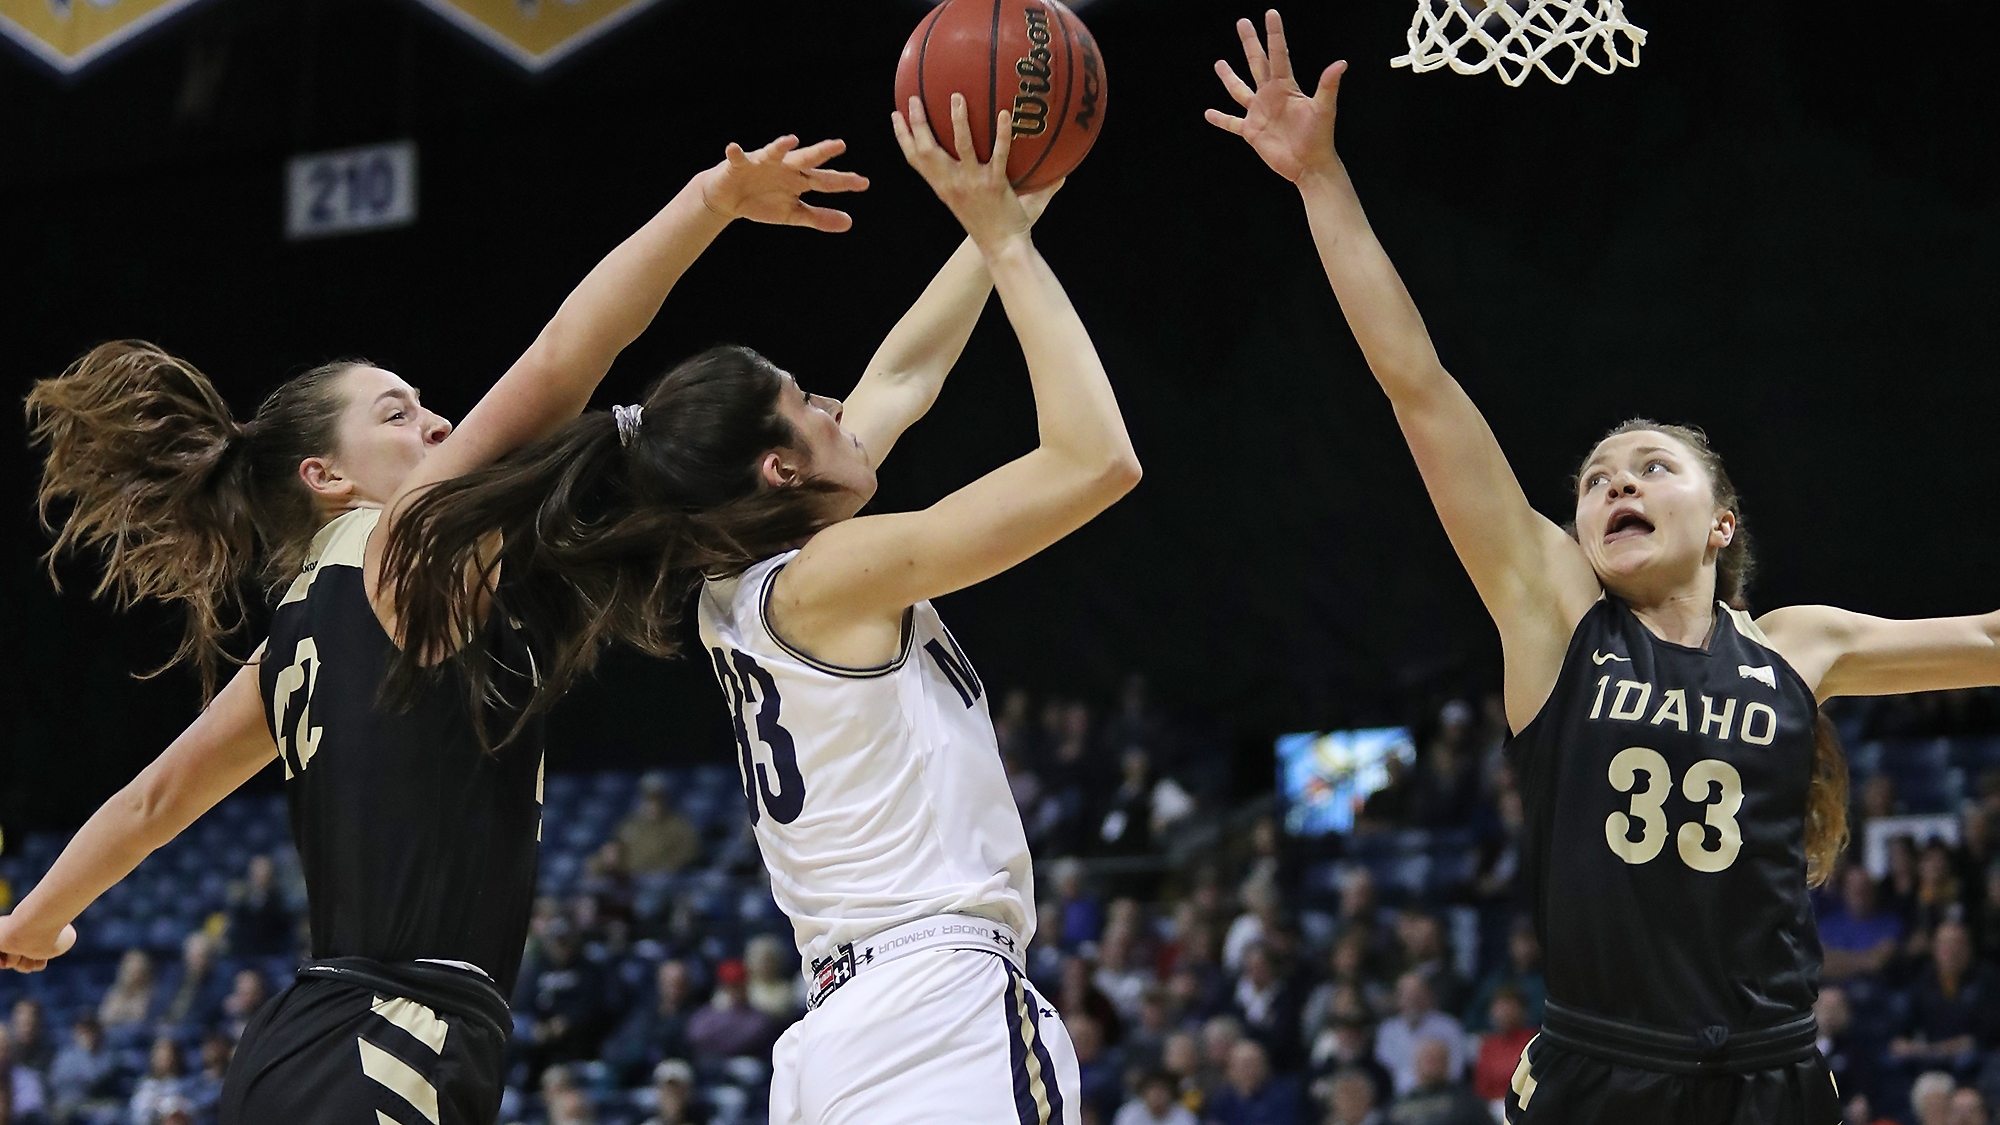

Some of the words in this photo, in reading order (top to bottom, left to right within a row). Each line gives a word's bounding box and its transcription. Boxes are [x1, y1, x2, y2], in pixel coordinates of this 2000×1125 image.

[1010, 7, 1052, 140] Wilson
[309, 155, 396, 222] 210
[1589, 674, 1777, 746] IDAHO
[1605, 746, 1746, 873] 33
[877, 927, 937, 955] ARMOUR
[941, 924, 990, 938] UNDER
